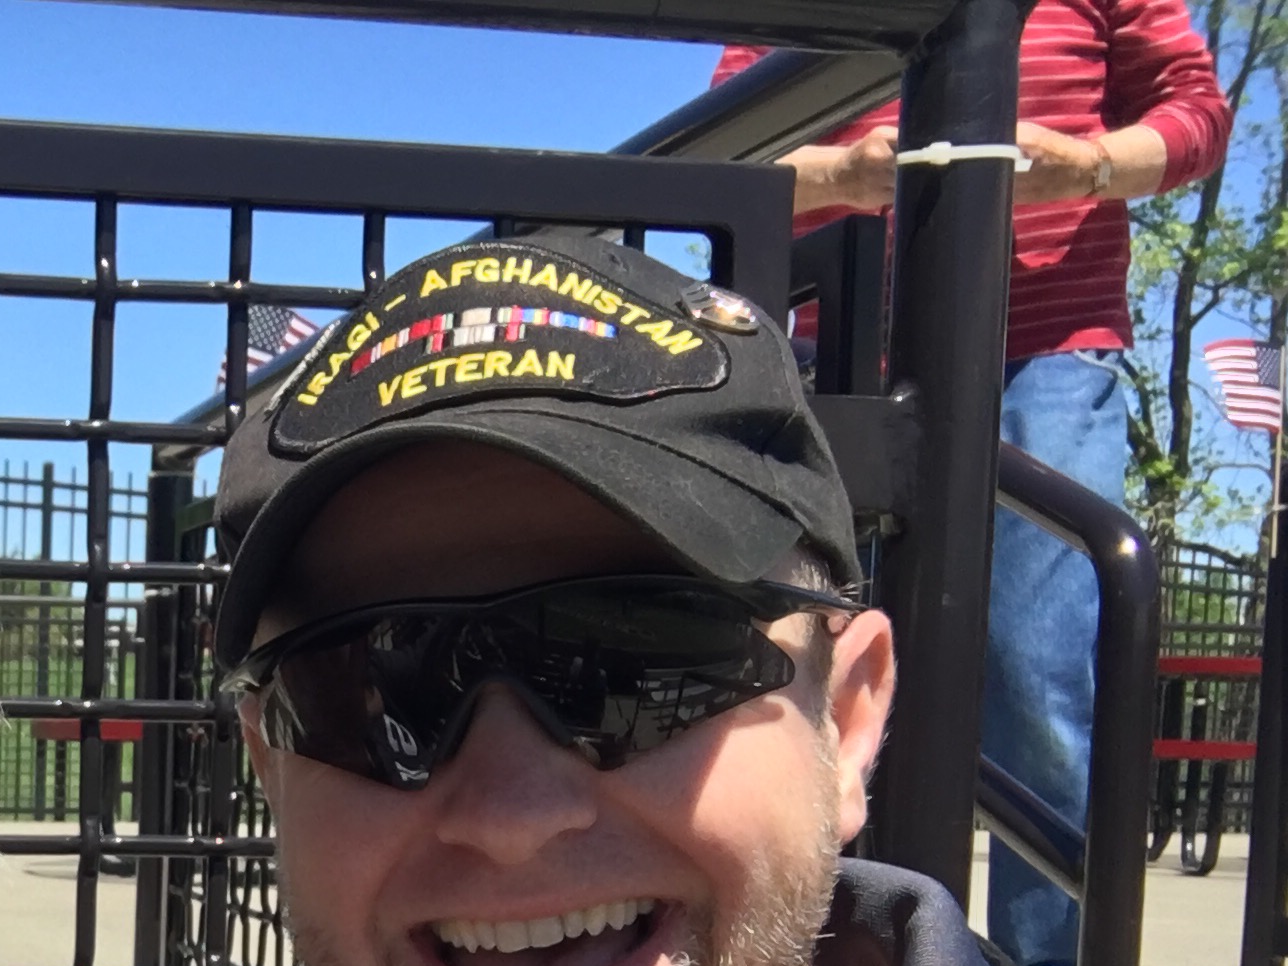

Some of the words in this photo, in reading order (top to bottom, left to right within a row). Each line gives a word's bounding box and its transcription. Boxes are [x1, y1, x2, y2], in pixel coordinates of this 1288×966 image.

[297, 310, 381, 407] IRAQI
[419, 257, 703, 356] AFGHANISTAN
[377, 352, 576, 407] VETERAN
